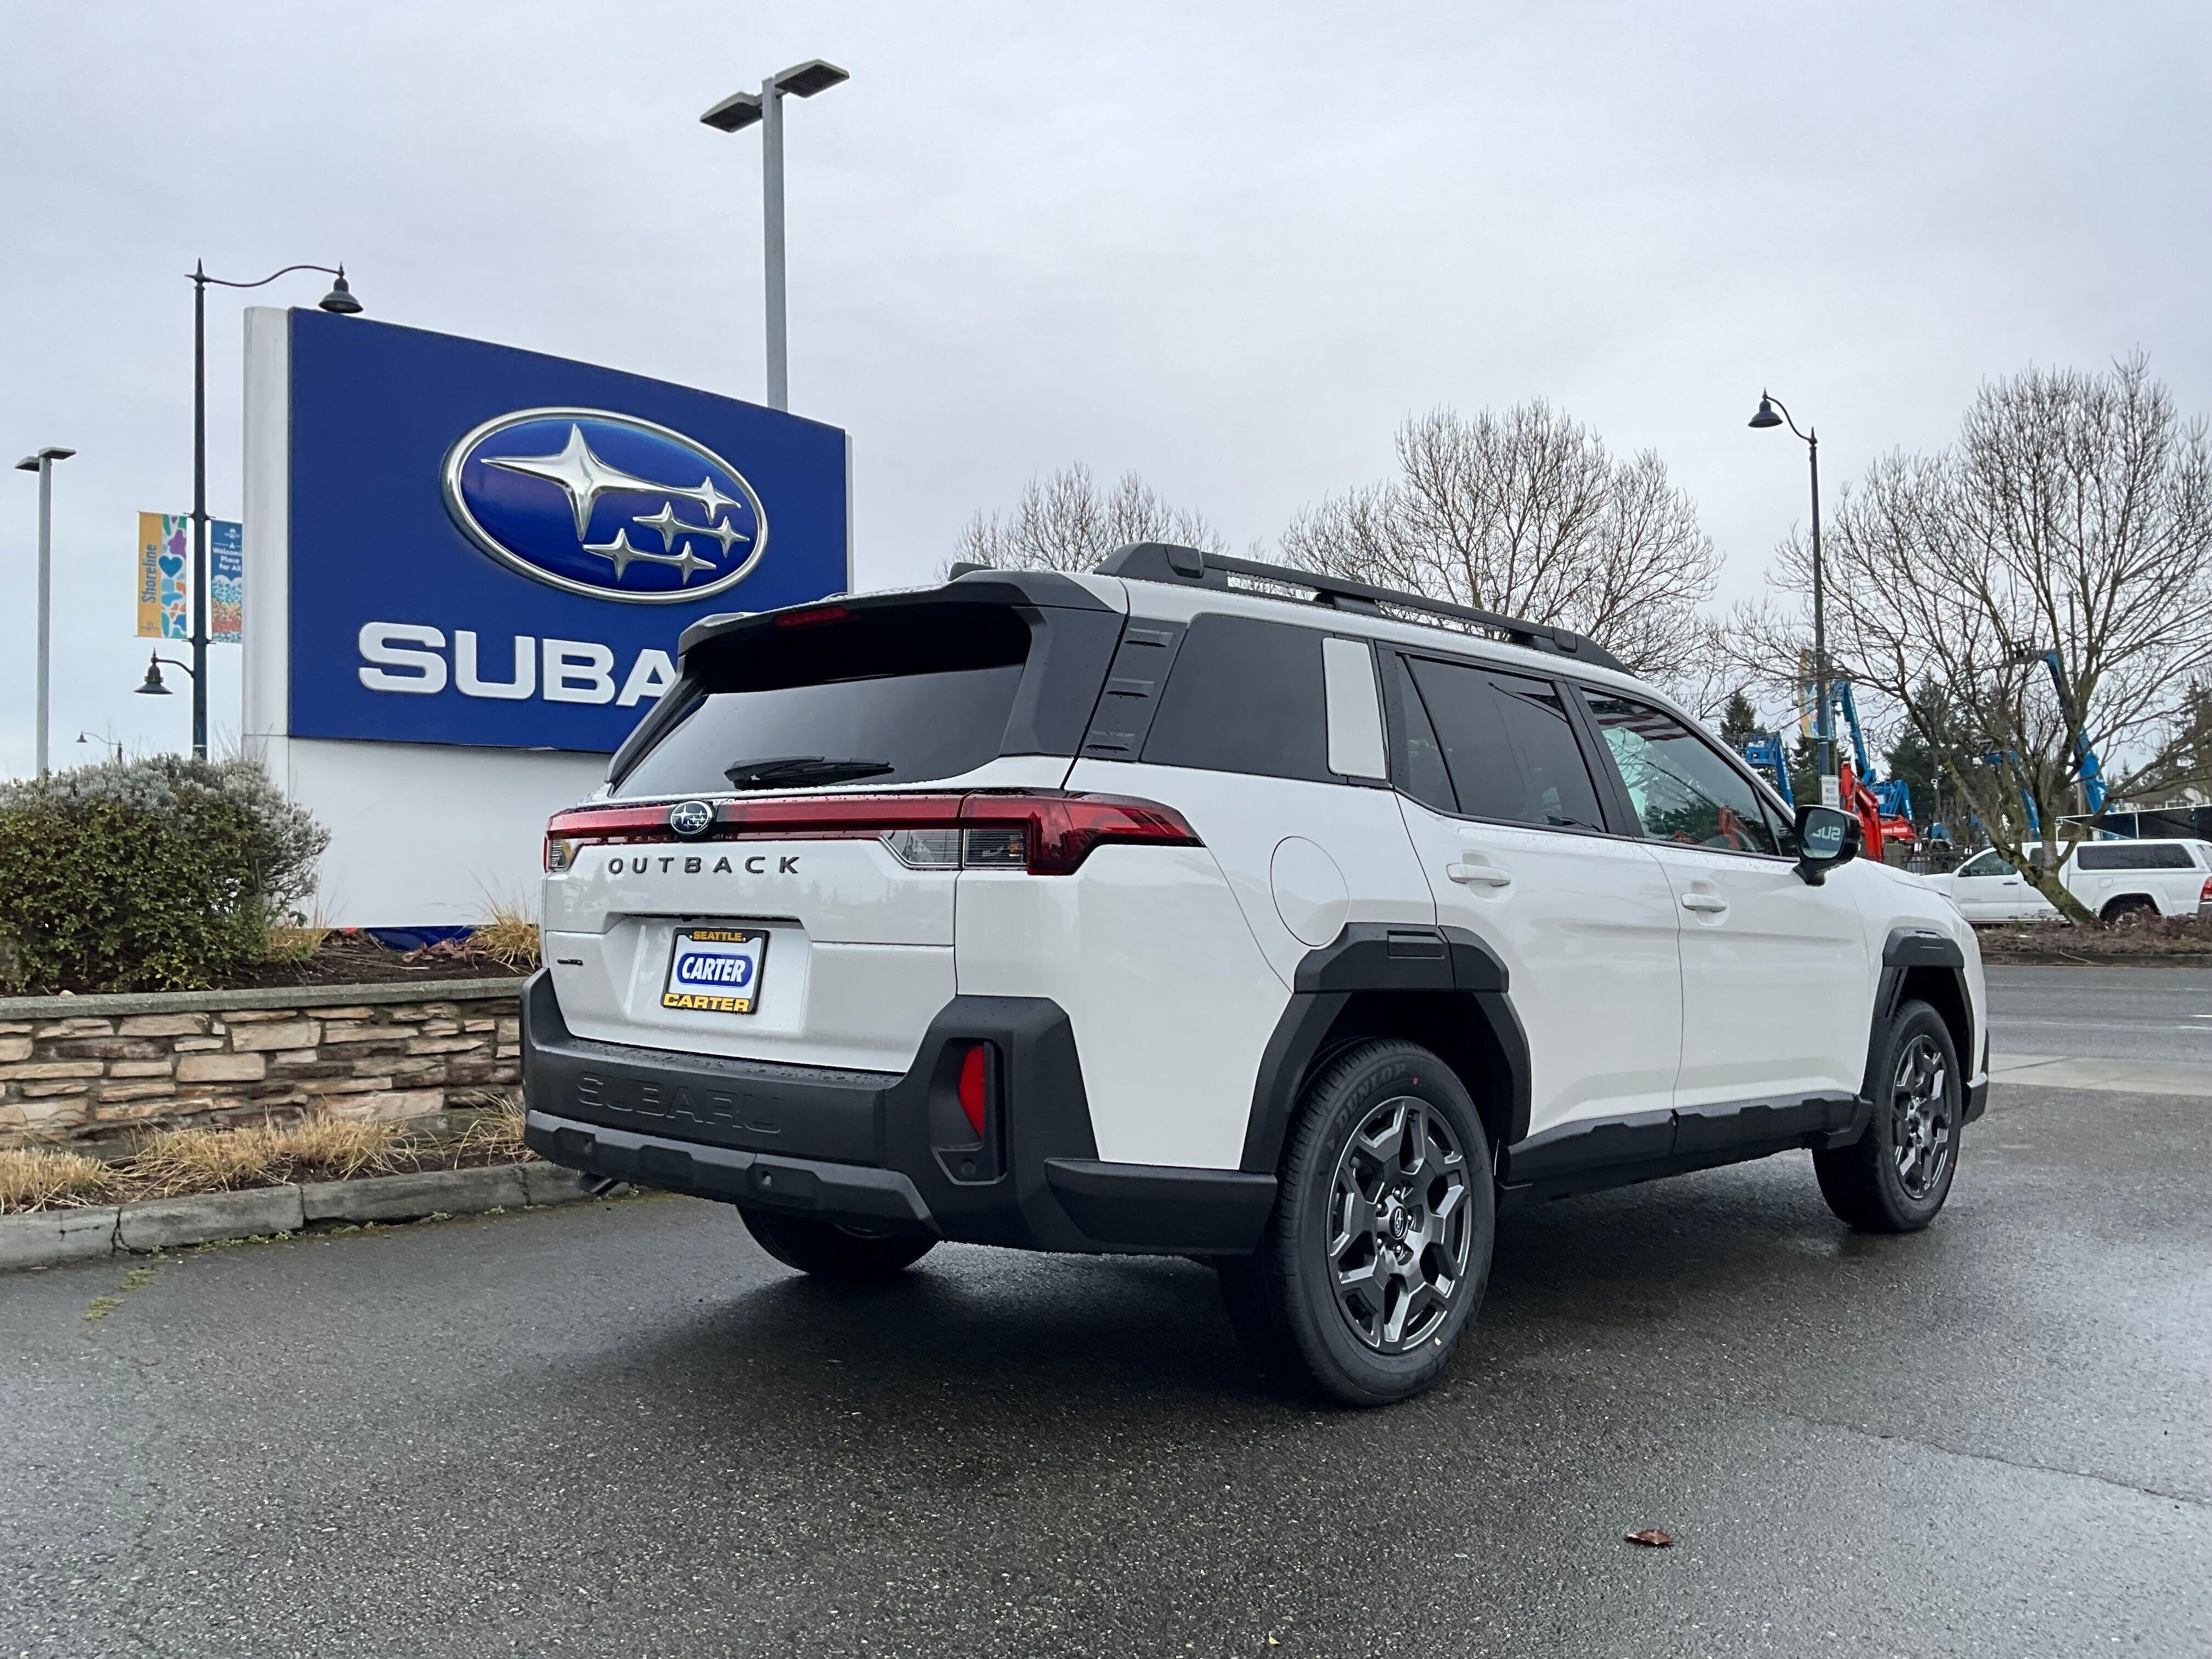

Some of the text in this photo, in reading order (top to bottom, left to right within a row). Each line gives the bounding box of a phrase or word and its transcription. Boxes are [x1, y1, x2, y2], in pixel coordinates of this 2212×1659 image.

[212, 547, 242, 557] Welcomi
[142, 544, 157, 603] Shoreline
[359, 621, 680, 707] SUBA
[608, 856, 799, 874] OUTBACK
[693, 930, 742, 941] SEATTLE
[682, 956, 746, 983] CARTER
[663, 993, 749, 1012] CARTER
[577, 1070, 781, 1135] SUBARU
